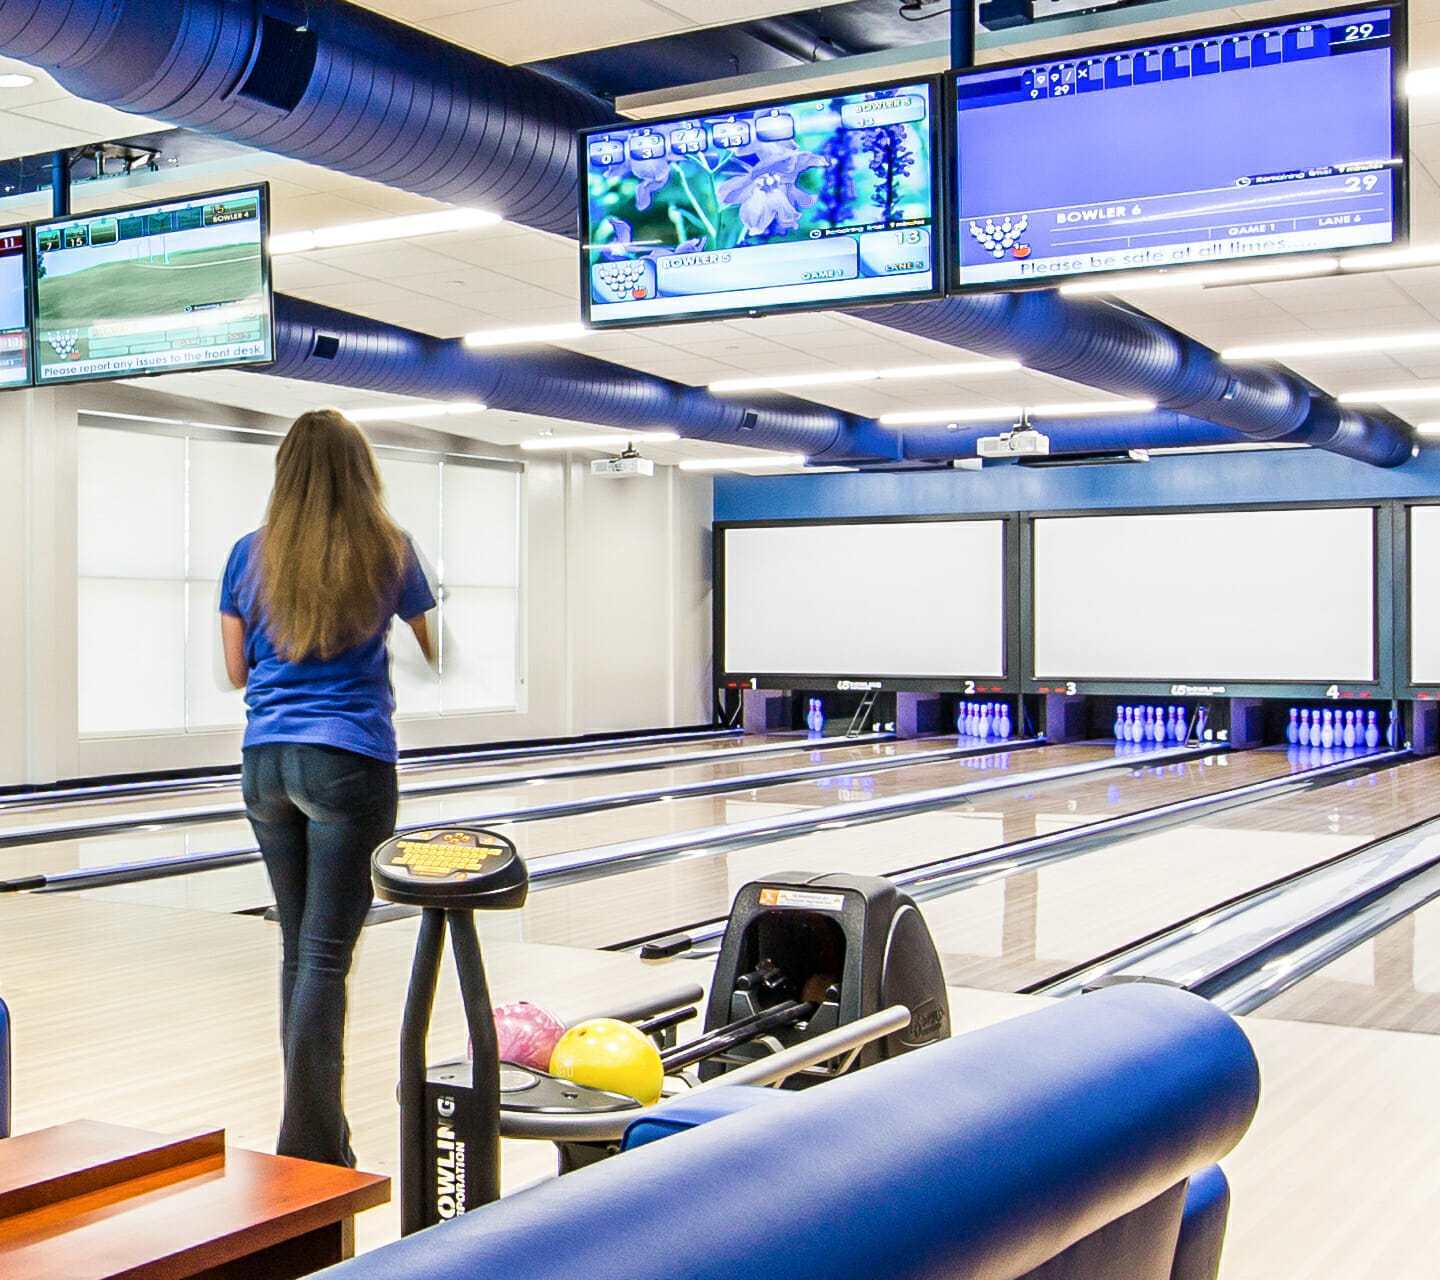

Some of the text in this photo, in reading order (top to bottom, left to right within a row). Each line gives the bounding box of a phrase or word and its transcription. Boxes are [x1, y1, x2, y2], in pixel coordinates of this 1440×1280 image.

[1345, 24, 1374, 40] 29
[1030, 85, 1070, 100] 9 29
[1344, 175, 1378, 193] 29
[212, 212, 242, 223] BOWLER
[1056, 204, 1142, 224] BOWLER 6
[1318, 215, 1351, 226] LANE
[1228, 223, 1276, 236] GAME 1
[3, 237, 15, 248] 11
[896, 230, 921, 246] 13
[663, 253, 732, 269] BOWLER 5
[1020, 258, 1084, 275] Please
[1090, 256, 1117, 269] be
[1123, 250, 1165, 264] safe
[1172, 247, 1190, 260] at
[1200, 243, 1223, 257] all
[44, 344, 262, 377] Please report any issues to the front desk
[749, 678, 757, 690] 1
[964, 681, 976, 694] 2
[1066, 682, 1077, 696] 3
[1326, 685, 1340, 699] 4
[437, 1097, 456, 1224] OWLING
